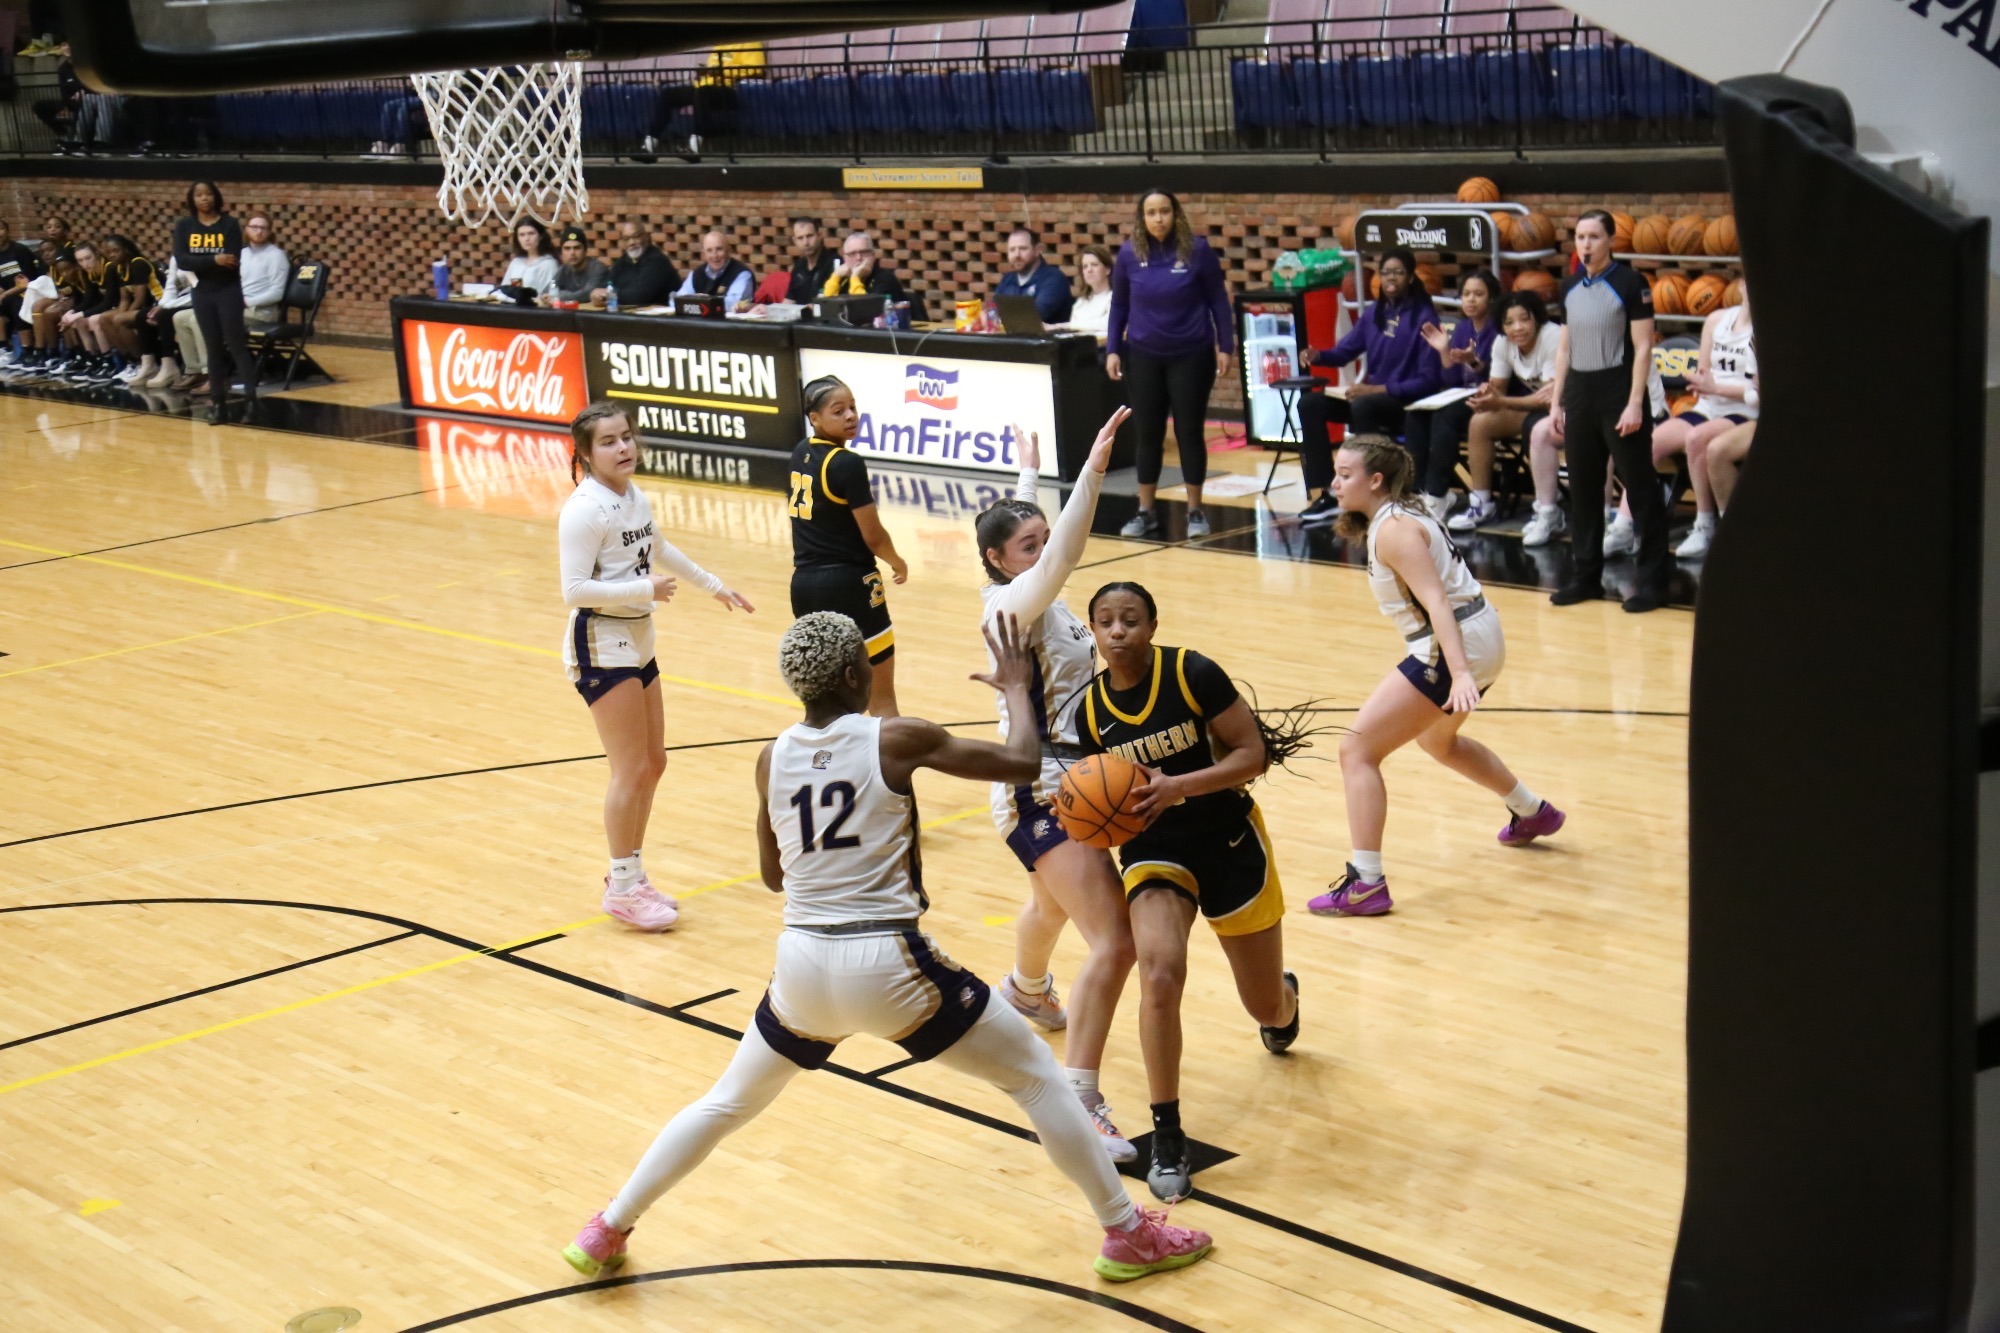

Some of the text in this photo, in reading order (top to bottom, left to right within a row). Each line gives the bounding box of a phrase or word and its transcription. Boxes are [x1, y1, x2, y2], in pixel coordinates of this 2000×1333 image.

[1396, 228, 1447, 246] SPALDING
[439, 327, 567, 416] Coca-Cola
[601, 341, 777, 400] 'SOUTHERN
[1718, 358, 1736, 373] 11
[637, 405, 747, 440] ATHLETICS
[850, 412, 1017, 466] AmFirst
[789, 471, 814, 521] 23
[621, 521, 653, 547] SEWANE
[634, 543, 652, 577] 14
[1106, 719, 1199, 764] OUTHERN
[790, 780, 861, 854] 12
